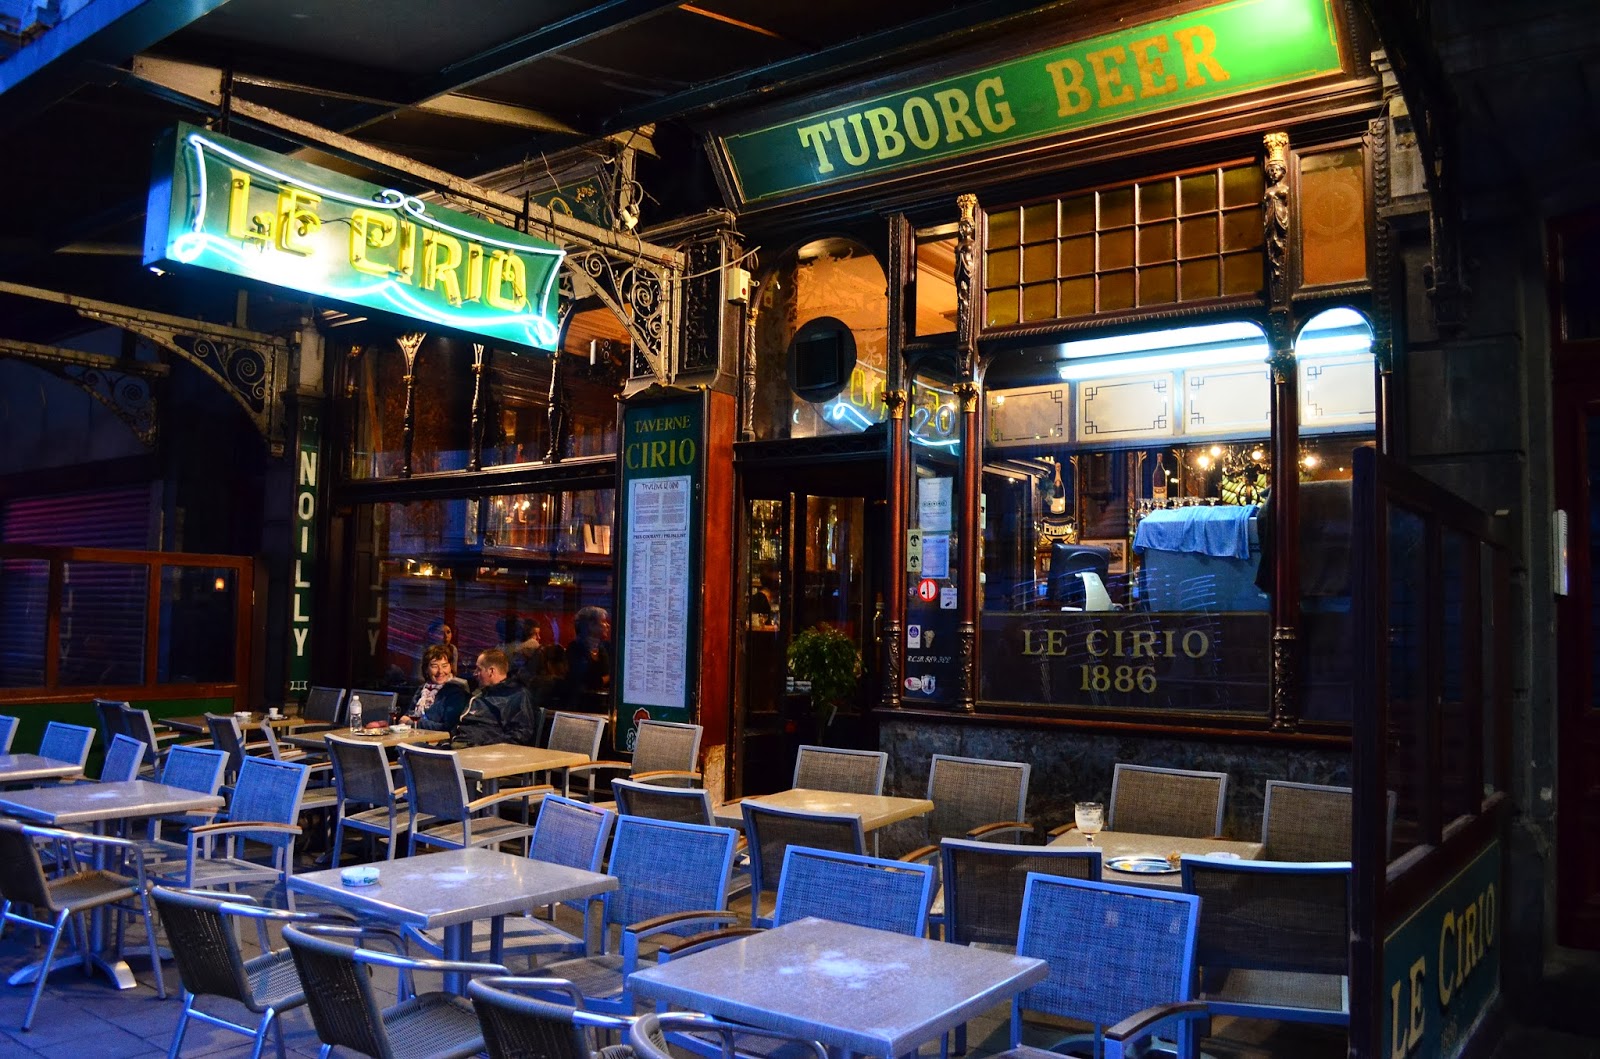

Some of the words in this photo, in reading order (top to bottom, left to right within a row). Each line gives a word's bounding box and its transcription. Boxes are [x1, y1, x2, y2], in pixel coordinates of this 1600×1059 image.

[797, 77, 1017, 174] TUBORG
[1045, 24, 1231, 119] BEER
[227, 167, 322, 258] LE
[349, 207, 528, 311] CIRIO
[625, 437, 696, 470] CIRIO
[634, 415, 691, 434] TAVERNE
[293, 451, 317, 656] NOILLY
[1021, 629, 1068, 656] LE
[1086, 629, 1210, 658] CIRIO
[1080, 664, 1158, 694] 1886
[1391, 955, 1426, 1059] LE
[1438, 882, 1495, 1006] CIRIO
